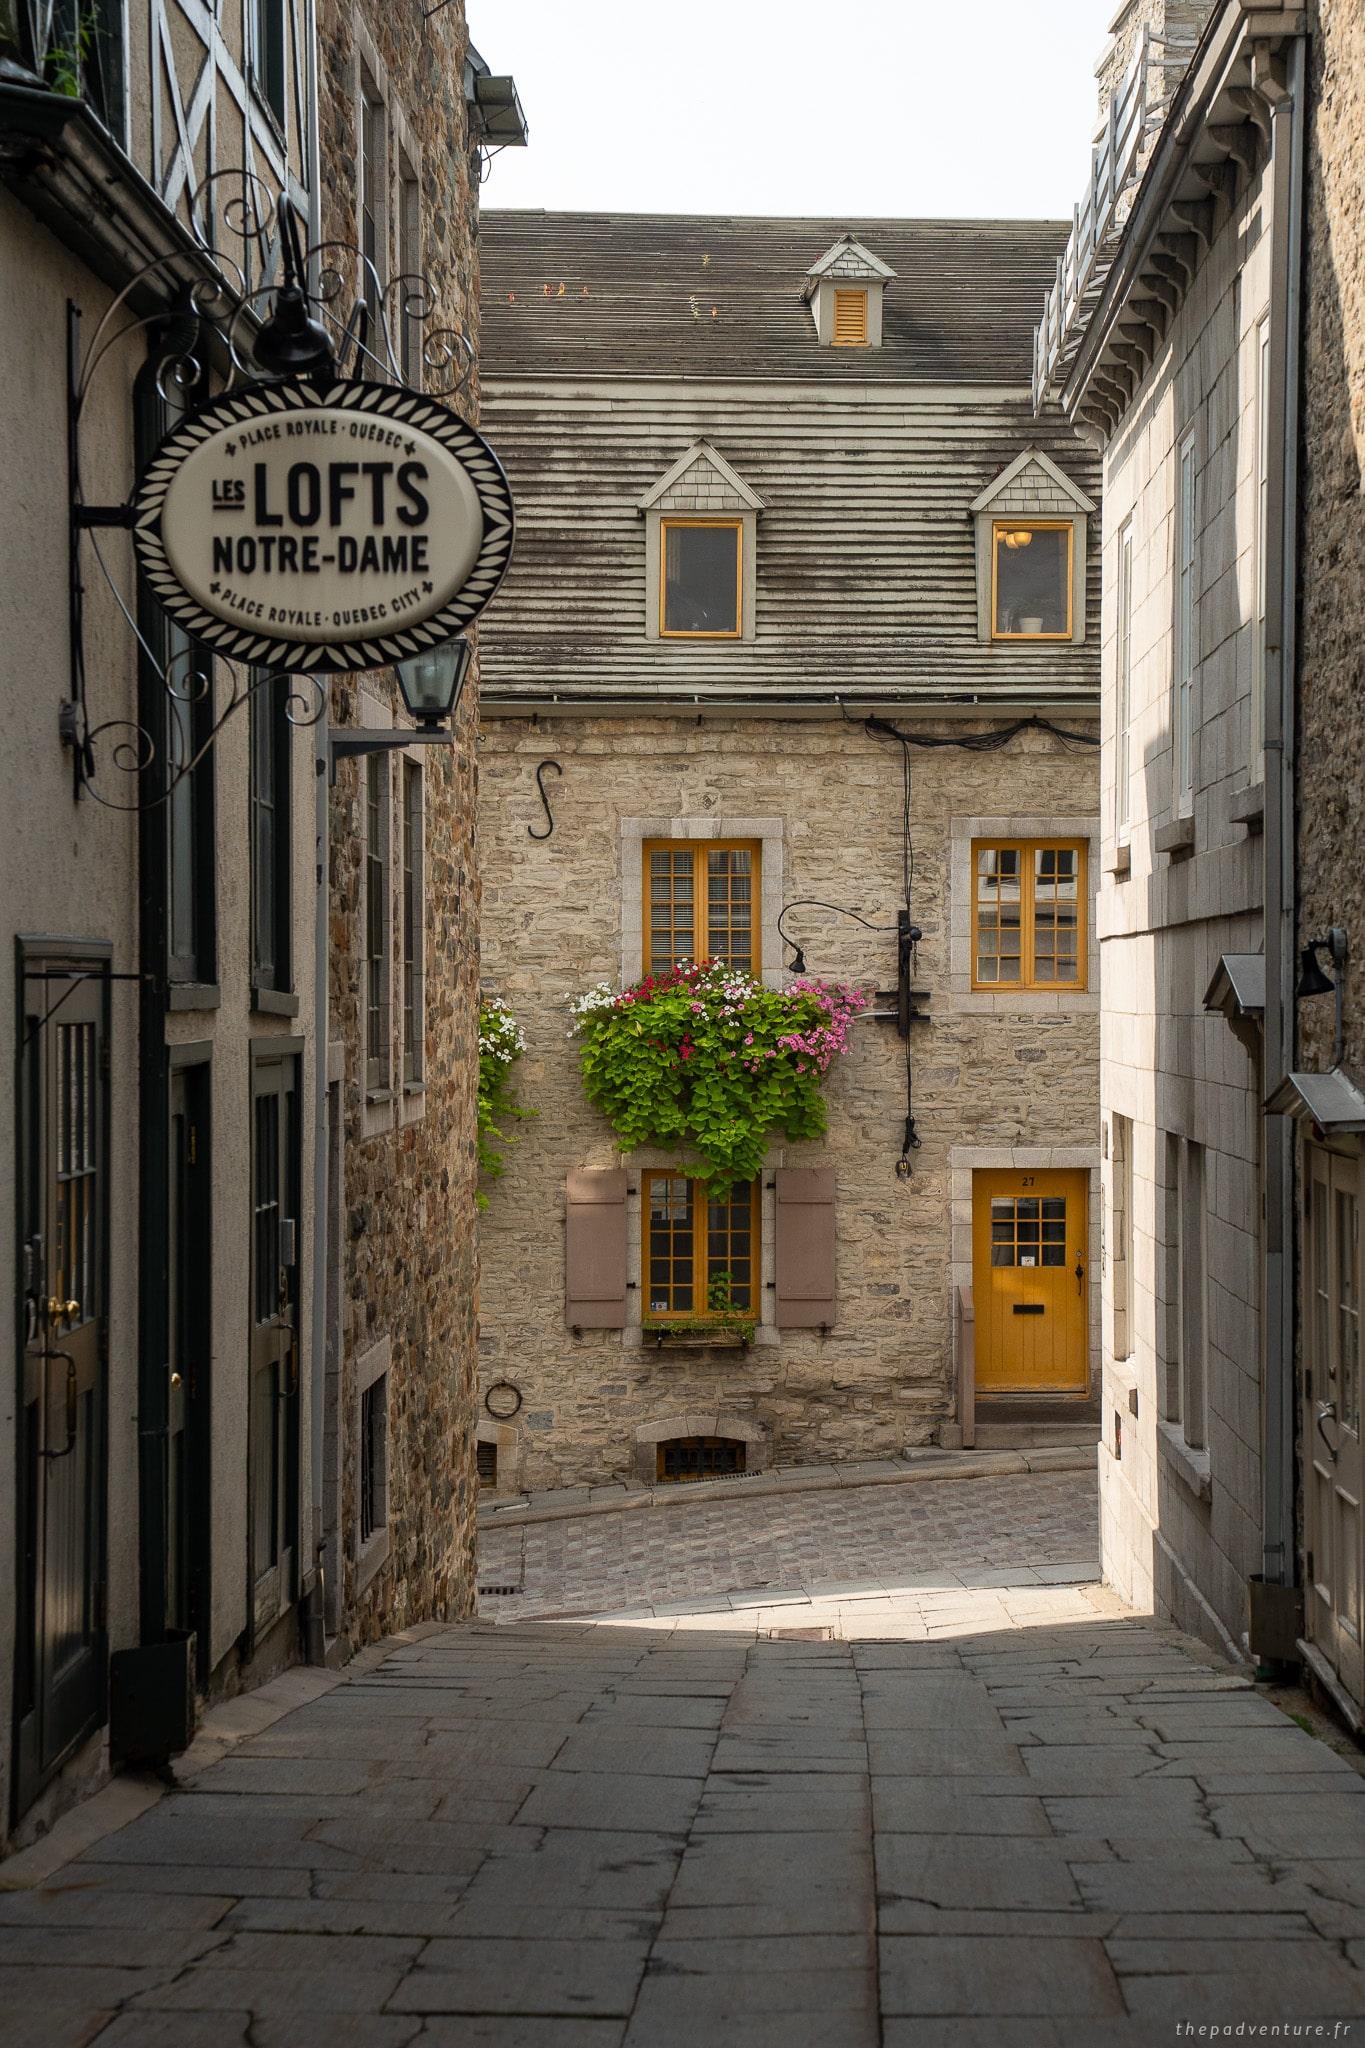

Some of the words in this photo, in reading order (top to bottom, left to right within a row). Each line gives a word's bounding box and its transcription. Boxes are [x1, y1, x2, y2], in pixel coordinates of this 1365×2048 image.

[239, 424, 281, 450] PLACE
[287, 420, 337, 436] ROYALE
[350, 422, 402, 449] QUÉBEC
[212, 479, 245, 501] LES
[254, 461, 429, 527] LOFTS
[212, 535, 429, 573] NOTRE-DAME
[221, 589, 264, 617] PLACE
[268, 608, 321, 626] ROYALE
[333, 605, 387, 626] QUEBEC
[392, 590, 421, 612] CITY
[1022, 1177, 1035, 1186] 27
